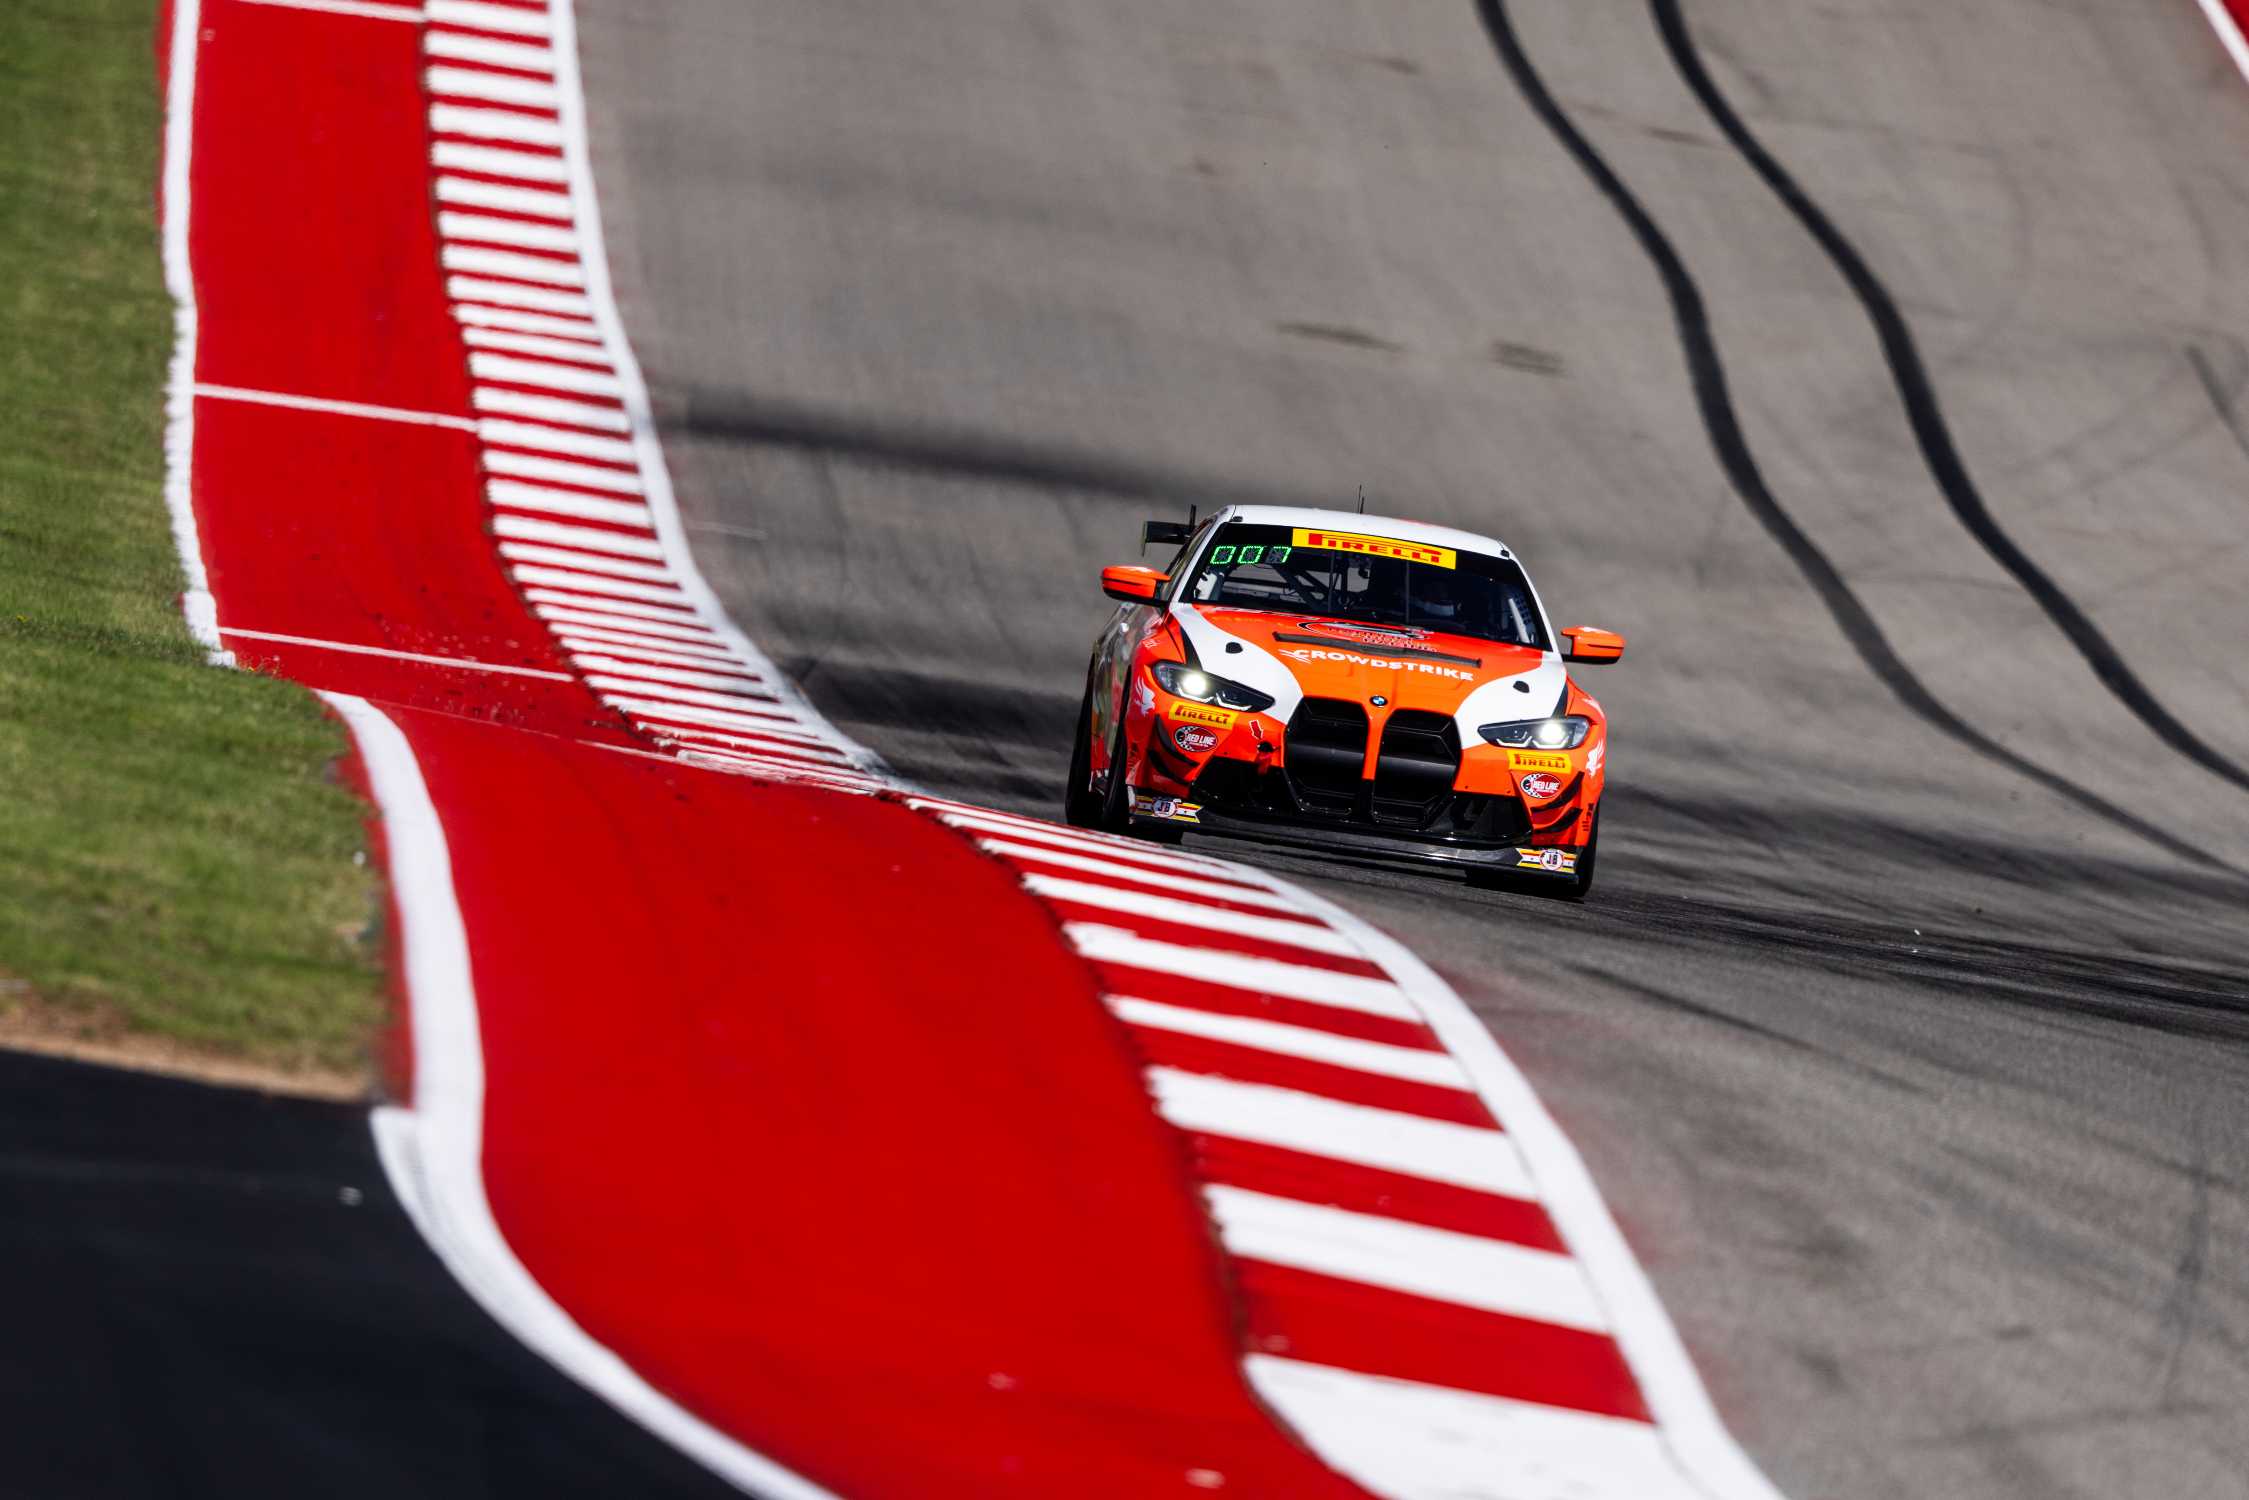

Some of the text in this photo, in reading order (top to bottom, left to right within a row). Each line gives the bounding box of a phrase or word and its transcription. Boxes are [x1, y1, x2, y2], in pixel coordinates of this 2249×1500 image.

[1307, 532, 1443, 564] PIRELLI
[1293, 649, 1475, 682] CROWDSTRIKE
[1174, 704, 1231, 725] PIRELLI
[1513, 753, 1566, 769] PIRELLI
